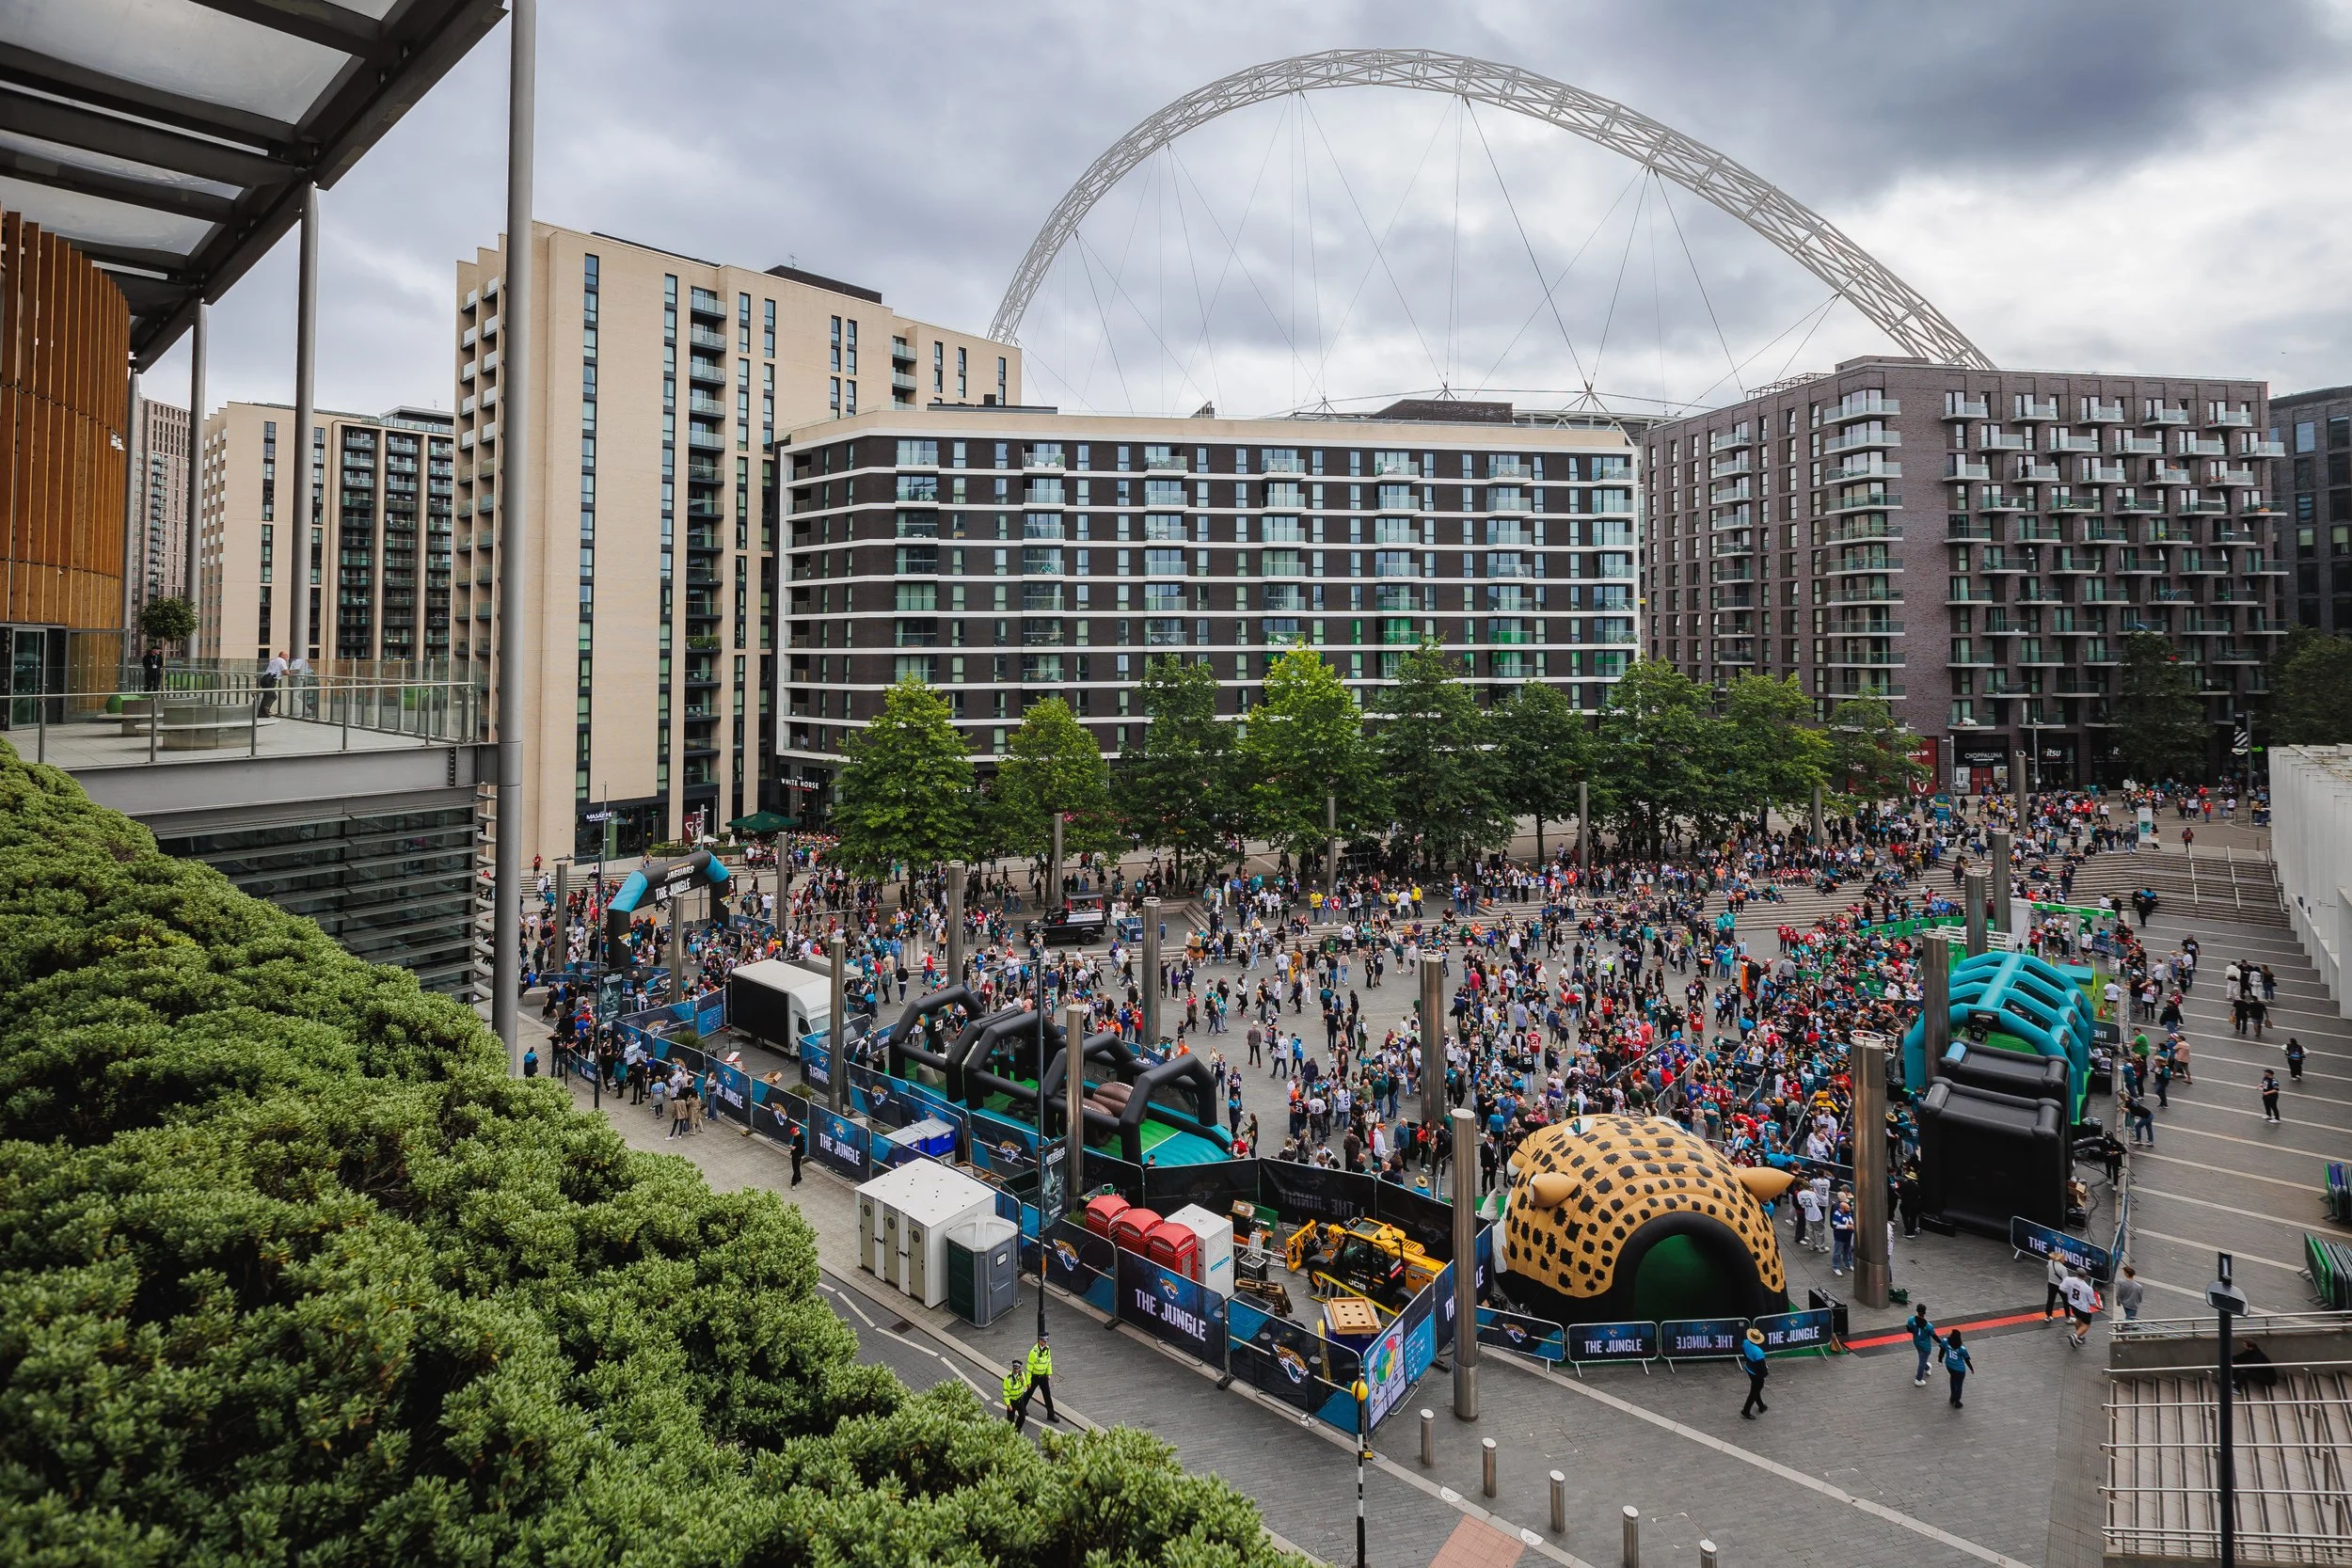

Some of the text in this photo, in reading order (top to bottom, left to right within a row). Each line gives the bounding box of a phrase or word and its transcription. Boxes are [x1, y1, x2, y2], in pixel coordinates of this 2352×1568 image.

[2046, 748, 2061, 756] itsu
[781, 778, 798, 786] WHITE
[800, 781, 819, 789] HORSE
[665, 865, 694, 881] JAGUARS
[655, 878, 691, 900] THE JUNGLE
[724, 1088, 743, 1110] JUNGLE
[819, 1132, 861, 1166] THE JUNGLE
[2027, 1236, 2048, 1254] THE
[1348, 1279, 1366, 1291] JCB
[1135, 1288, 1207, 1342] THE JUNGLE
[1768, 1325, 1820, 1346] THE JUNGLE
[1584, 1338, 1643, 1354] THE JUNGLE
